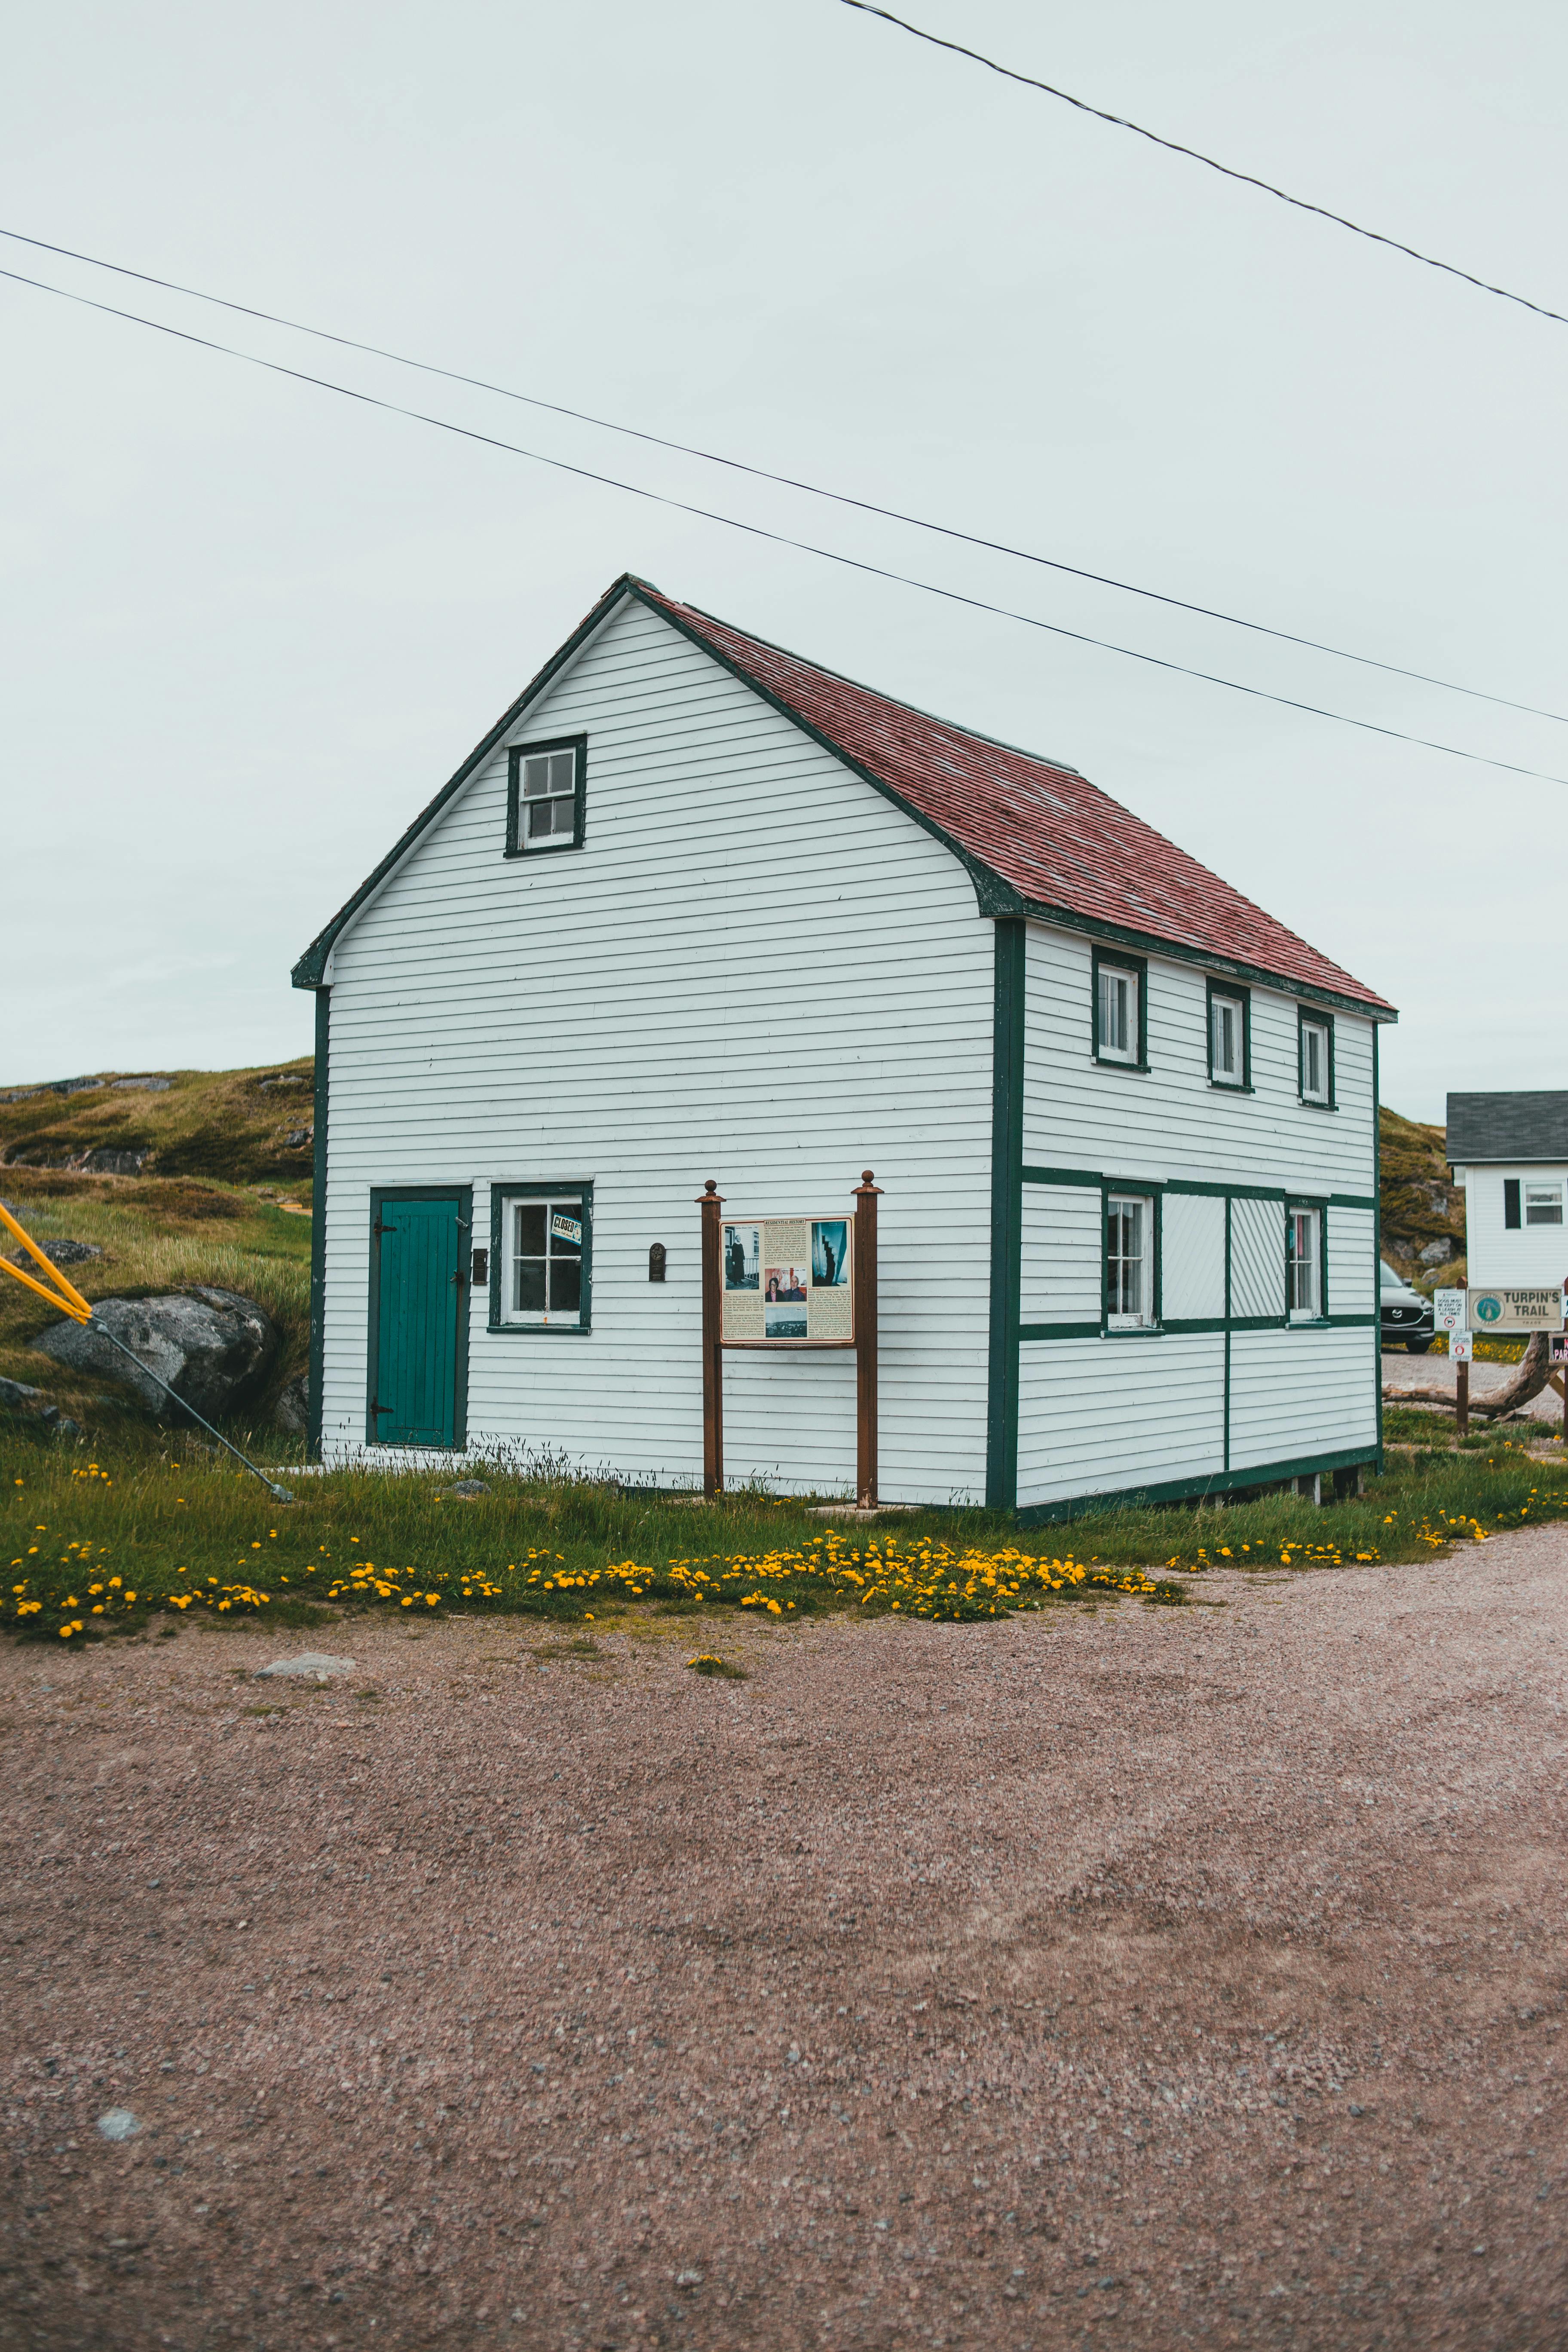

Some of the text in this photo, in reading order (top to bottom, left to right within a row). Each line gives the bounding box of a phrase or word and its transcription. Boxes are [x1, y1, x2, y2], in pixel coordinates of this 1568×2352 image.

[554, 1216, 575, 1233] CLOSED
[1504, 1292, 1559, 1304] TURPIN'S
[1514, 1305, 1549, 1316] TRAIL
[1554, 1349, 1568, 1361] PAR
